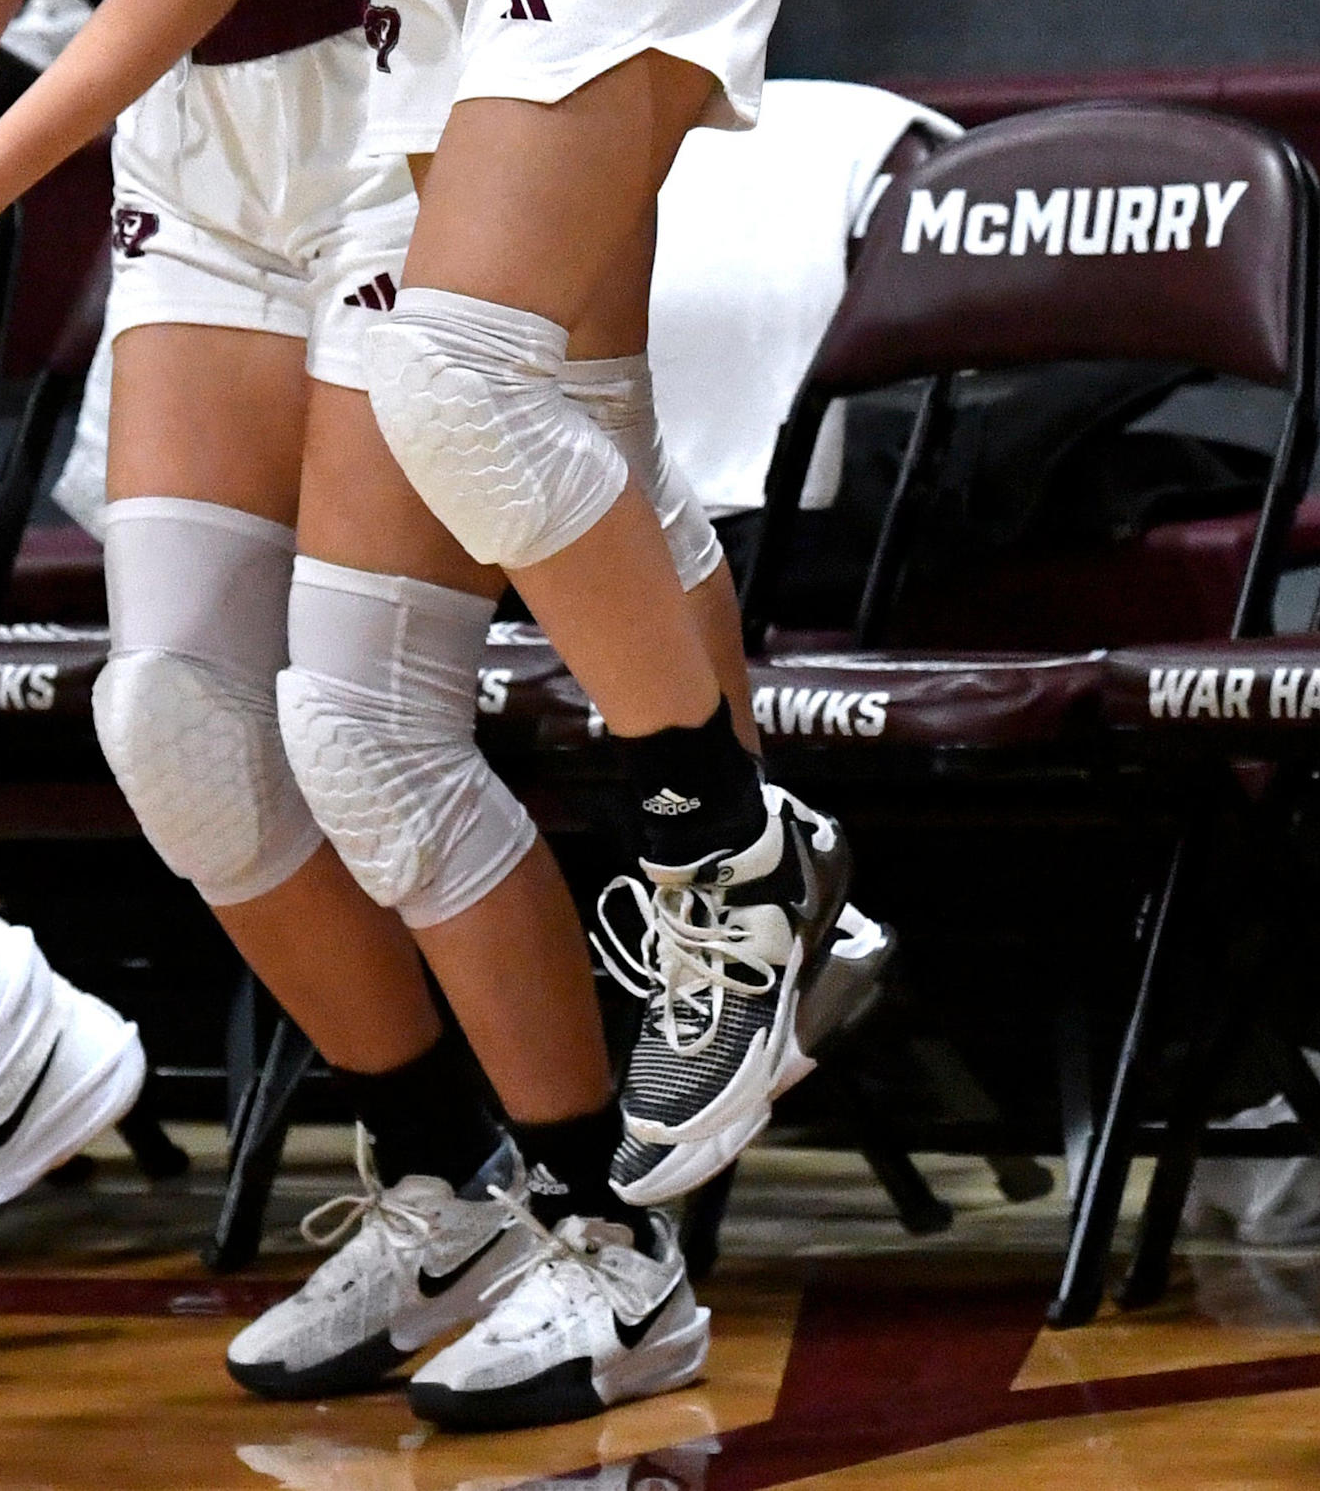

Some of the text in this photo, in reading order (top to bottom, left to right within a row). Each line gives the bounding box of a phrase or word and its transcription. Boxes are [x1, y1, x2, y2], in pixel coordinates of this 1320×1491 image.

[901, 180, 1250, 256] McMURRY
[752, 687, 890, 737] AWKS
[1148, 667, 1256, 719] WAR
[642, 796, 701, 816] adidas
